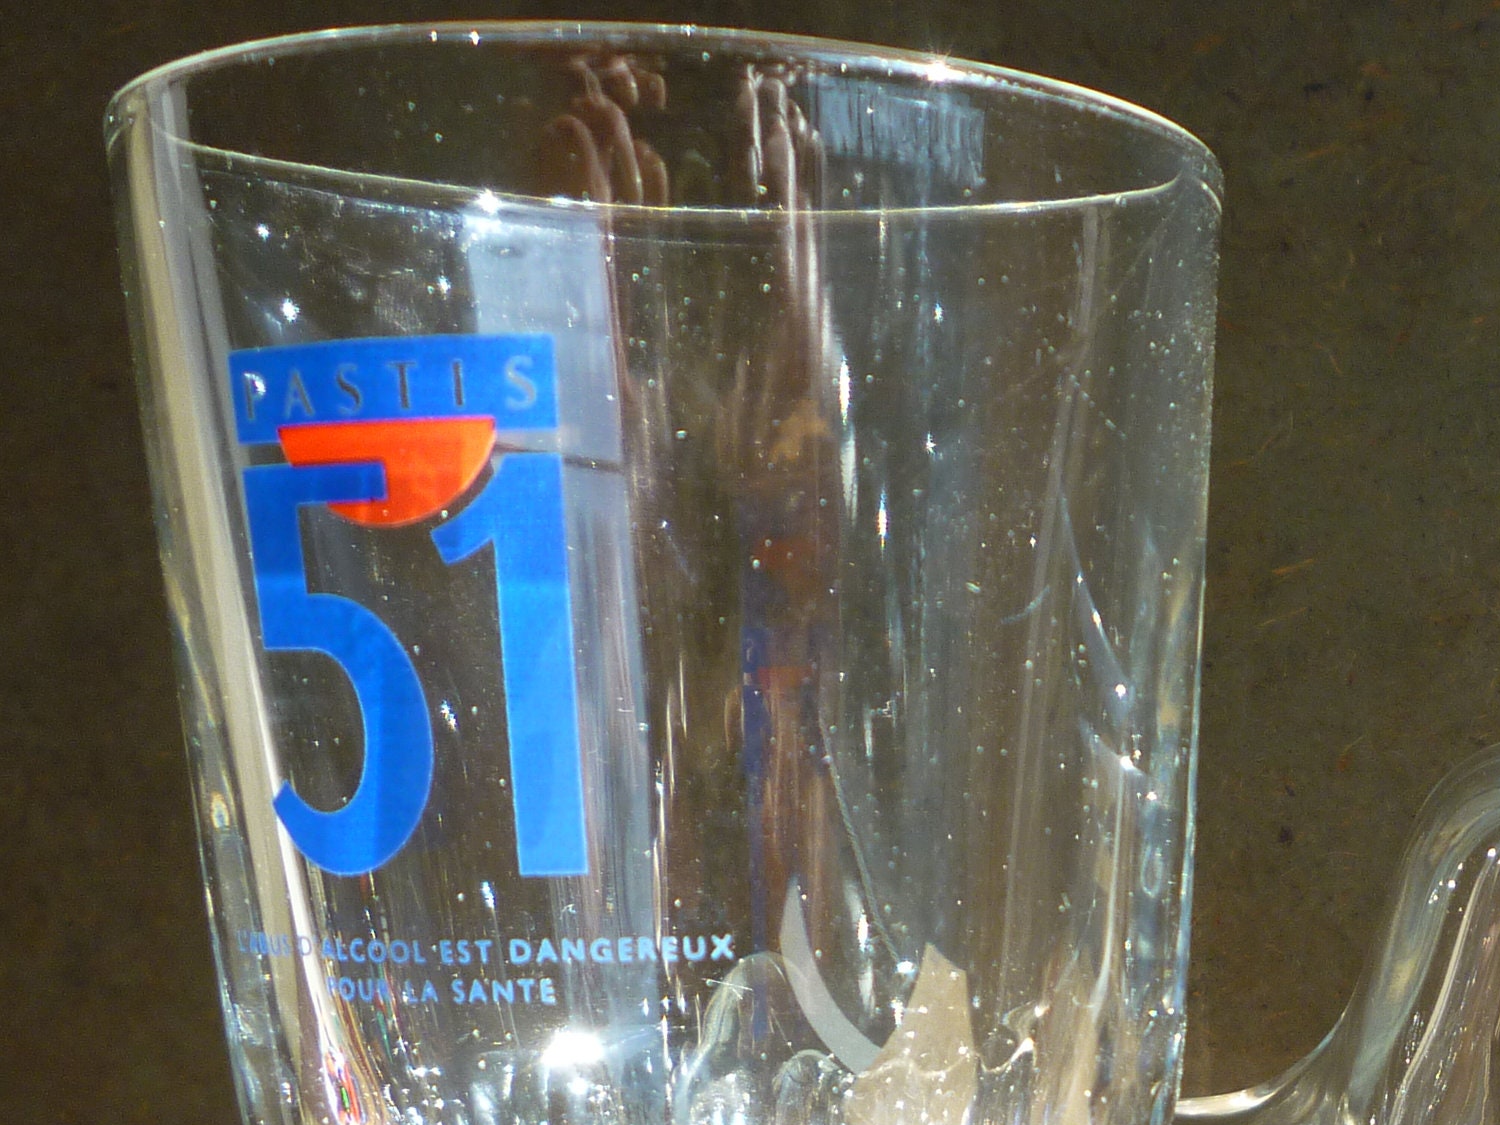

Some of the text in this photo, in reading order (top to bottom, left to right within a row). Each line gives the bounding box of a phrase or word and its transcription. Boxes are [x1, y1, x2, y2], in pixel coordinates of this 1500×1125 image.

[243, 354, 537, 422] PASTIS
[243, 452, 588, 876] 51
[439, 938, 493, 965] EST
[508, 933, 735, 965] DANGEREUX
[326, 975, 391, 1002] POUR
[404, 979, 439, 1005] LA
